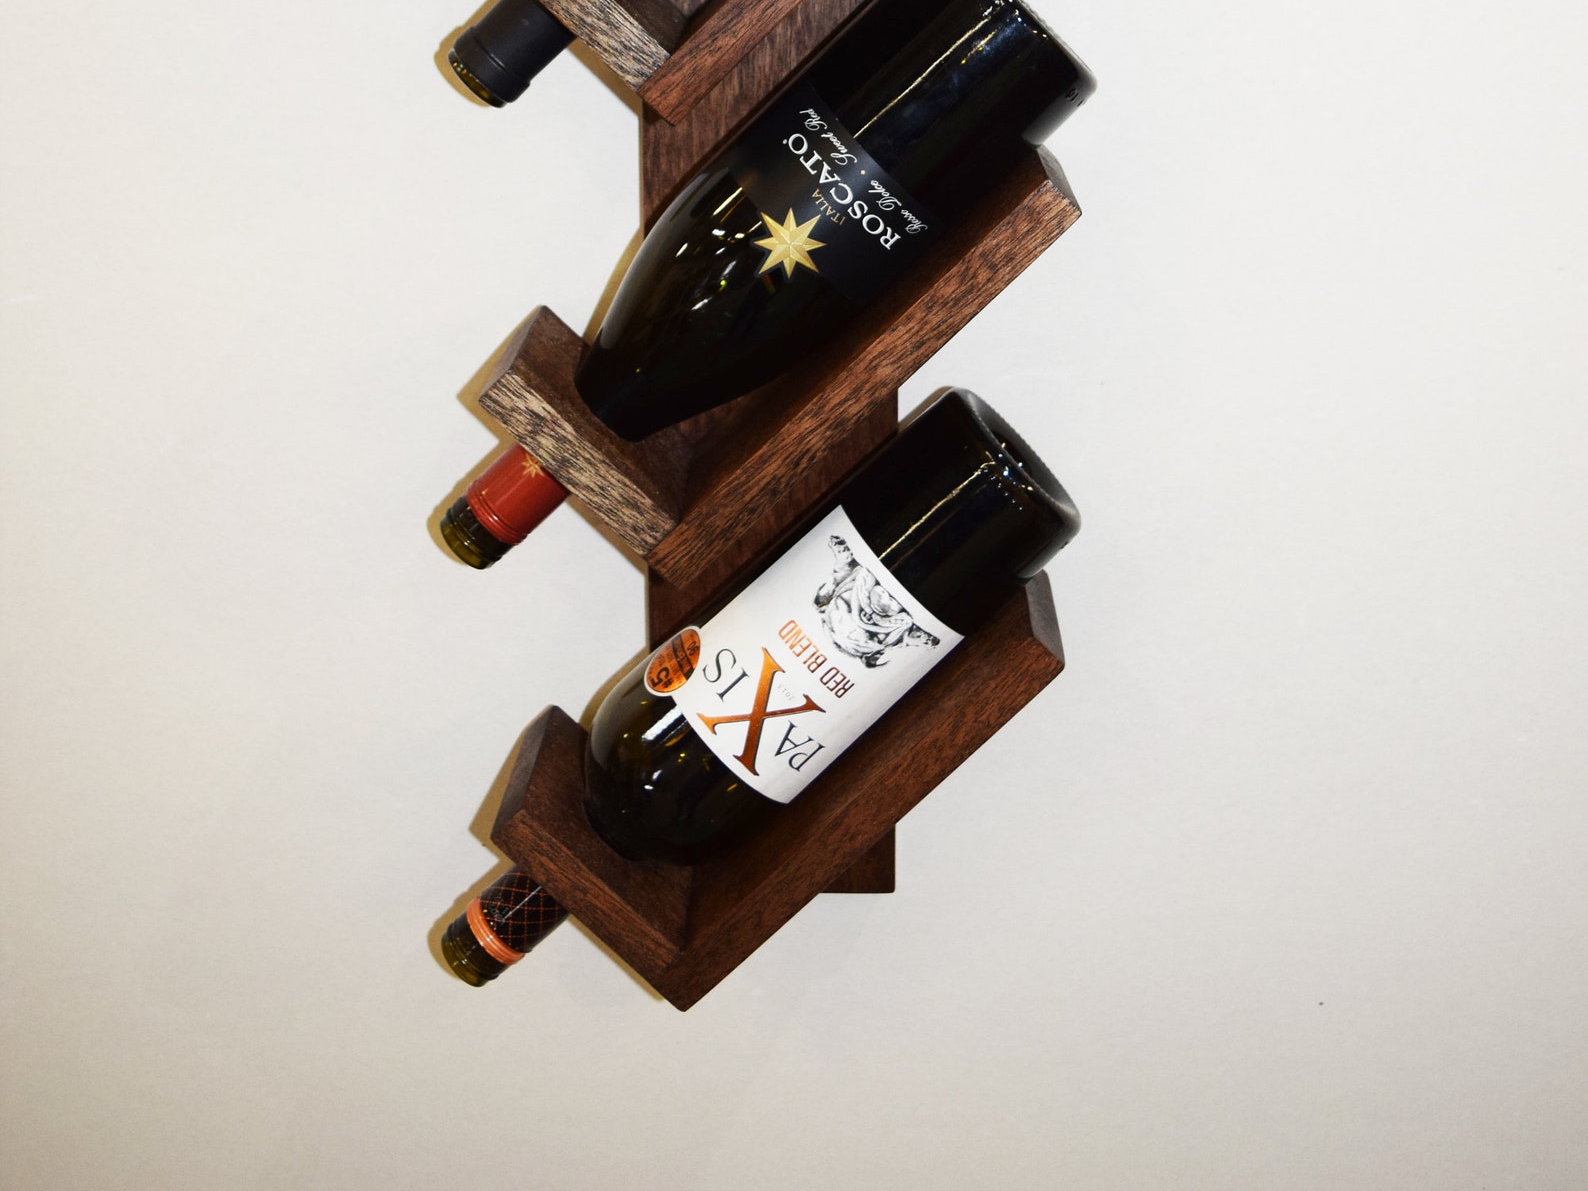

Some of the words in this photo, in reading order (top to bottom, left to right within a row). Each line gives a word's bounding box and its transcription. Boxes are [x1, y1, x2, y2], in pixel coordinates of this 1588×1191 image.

[799, 107, 828, 132] Red
[820, 130, 858, 167] Sweet
[783, 129, 901, 250] ROSCATO
[810, 187, 846, 226] ITALIA
[867, 178, 902, 213] Dolce
[900, 207, 928, 236] Rosso
[686, 640, 699, 656] 90
[776, 618, 828, 673] BLEND
[649, 668, 674, 689] #5
[818, 665, 855, 699] RED
[696, 646, 826, 776] PAXIS
